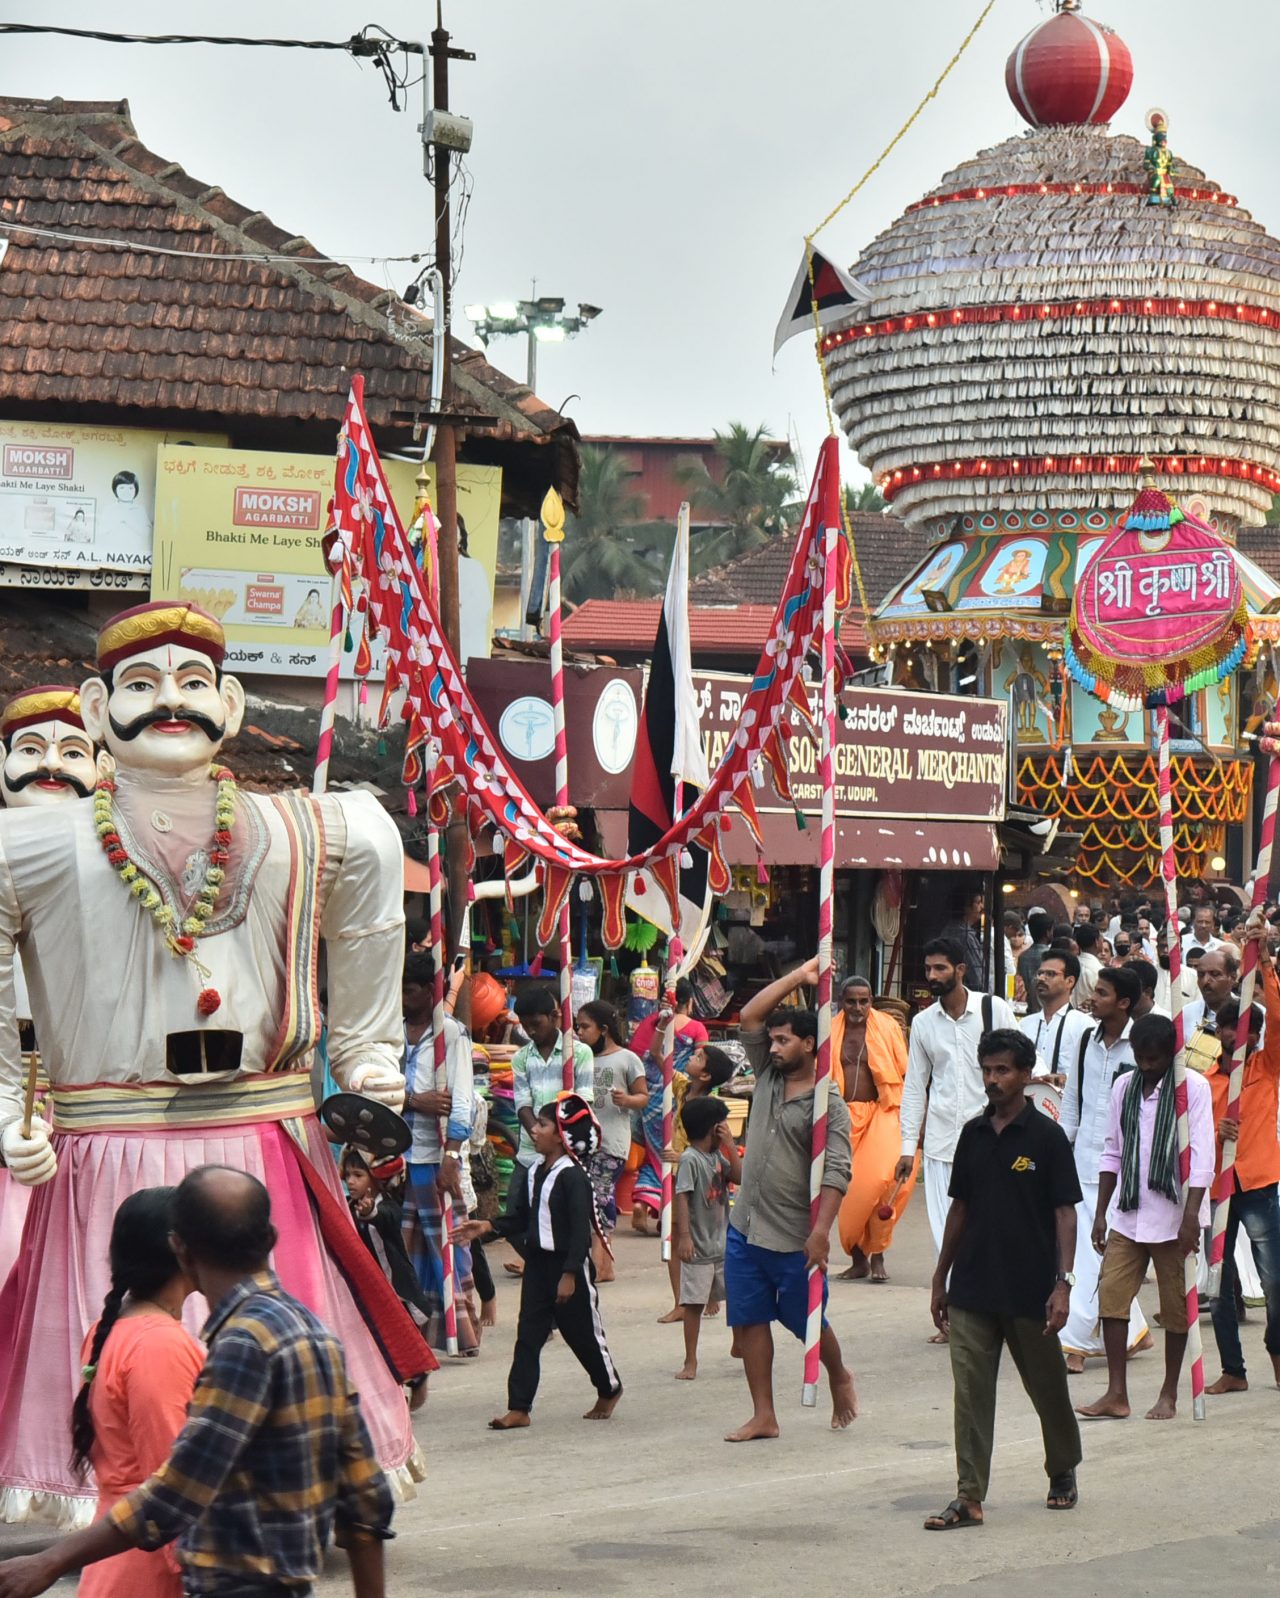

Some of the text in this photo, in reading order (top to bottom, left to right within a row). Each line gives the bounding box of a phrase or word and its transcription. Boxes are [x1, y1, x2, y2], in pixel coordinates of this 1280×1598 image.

[9, 450, 67, 466] MOKSH
[12, 465, 64, 476] AGARBATTI
[0, 480, 85, 493] akti Me Laye Shakti
[242, 493, 313, 513] MOKSH
[245, 512, 309, 525] AGARBATTI
[206, 530, 246, 544] Bhakti
[250, 533, 269, 545] Me
[273, 534, 302, 549] Laye
[76, 551, 102, 562] A.L.
[106, 552, 153, 566] NAYAK
[1098, 560, 1134, 609] श्री
[1200, 551, 1233, 599] श्री
[249, 587, 281, 599] Swarna
[247, 599, 281, 611] Champa
[270, 651, 283, 664] &
[834, 742, 913, 785] GENERAL
[916, 749, 1003, 790] MERCHANTS
[791, 783, 879, 803] CARSTET, UDUPI.
